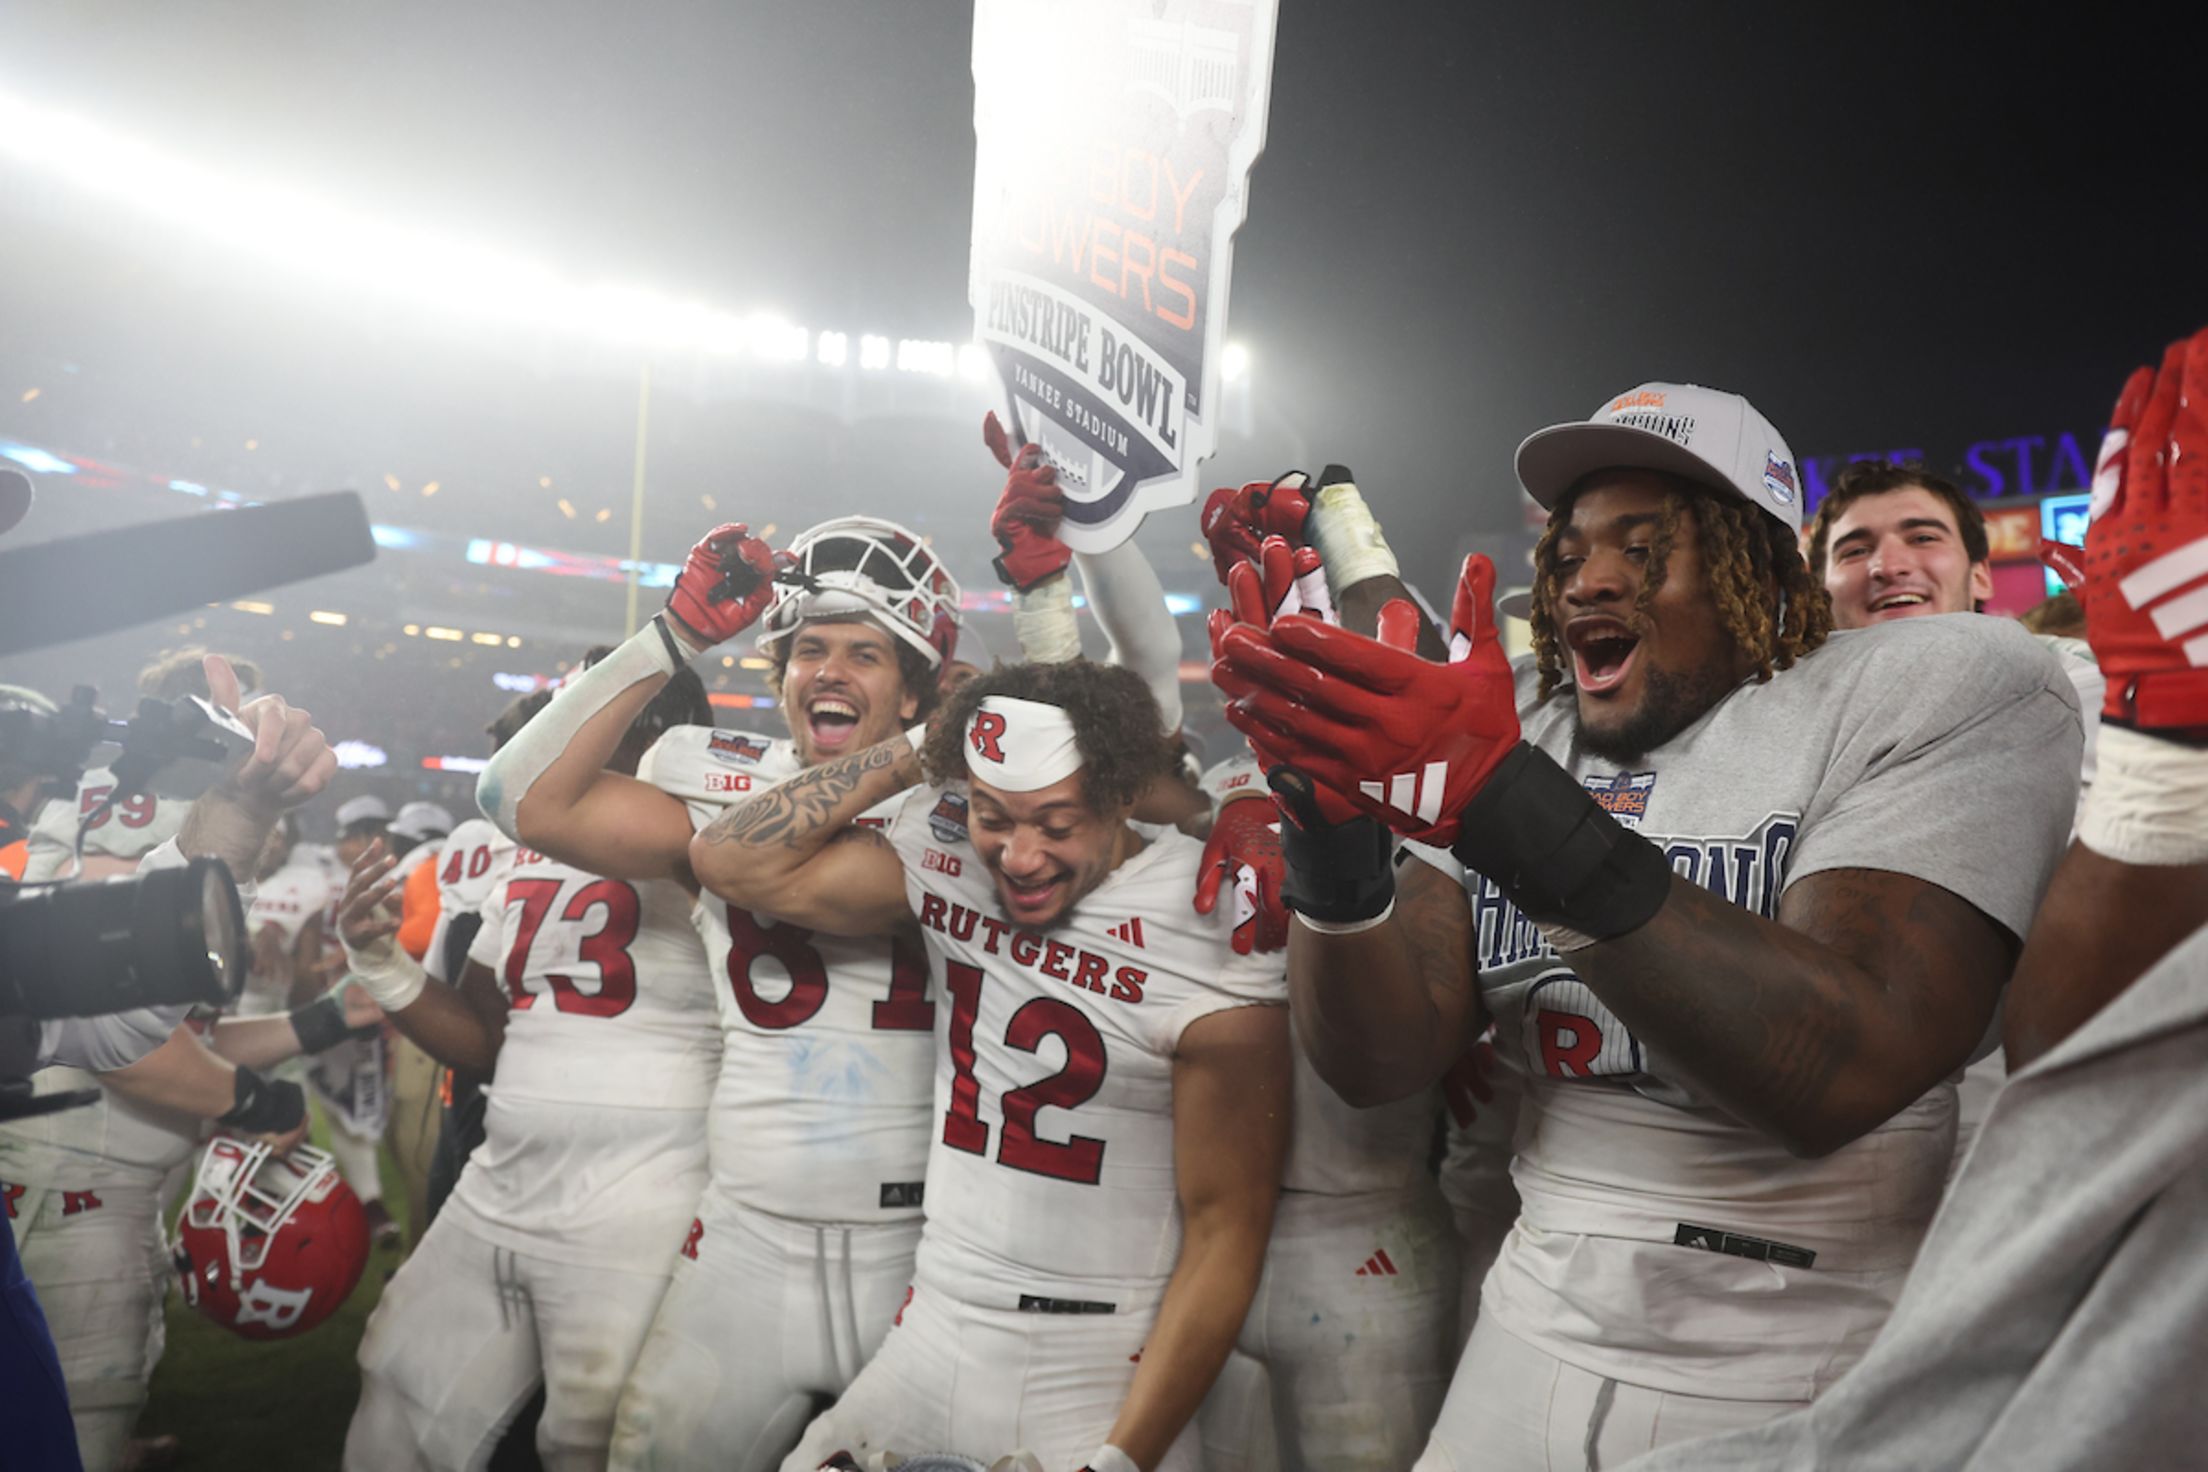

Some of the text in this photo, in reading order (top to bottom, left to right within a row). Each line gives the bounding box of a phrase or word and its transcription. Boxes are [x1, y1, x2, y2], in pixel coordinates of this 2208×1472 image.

[987, 281, 1177, 450] PINSTRIPE BOWL
[1014, 363, 1129, 457] YANKEE STADIUM
[969, 709, 1007, 764] R
[79, 785, 157, 830] 59
[440, 844, 492, 885] 40
[504, 877, 640, 1019] 73
[727, 900, 936, 1032] 81
[920, 891, 1149, 1004] RUTGERS
[942, 957, 1108, 1186] 12
[1537, 1009, 1602, 1078] R
